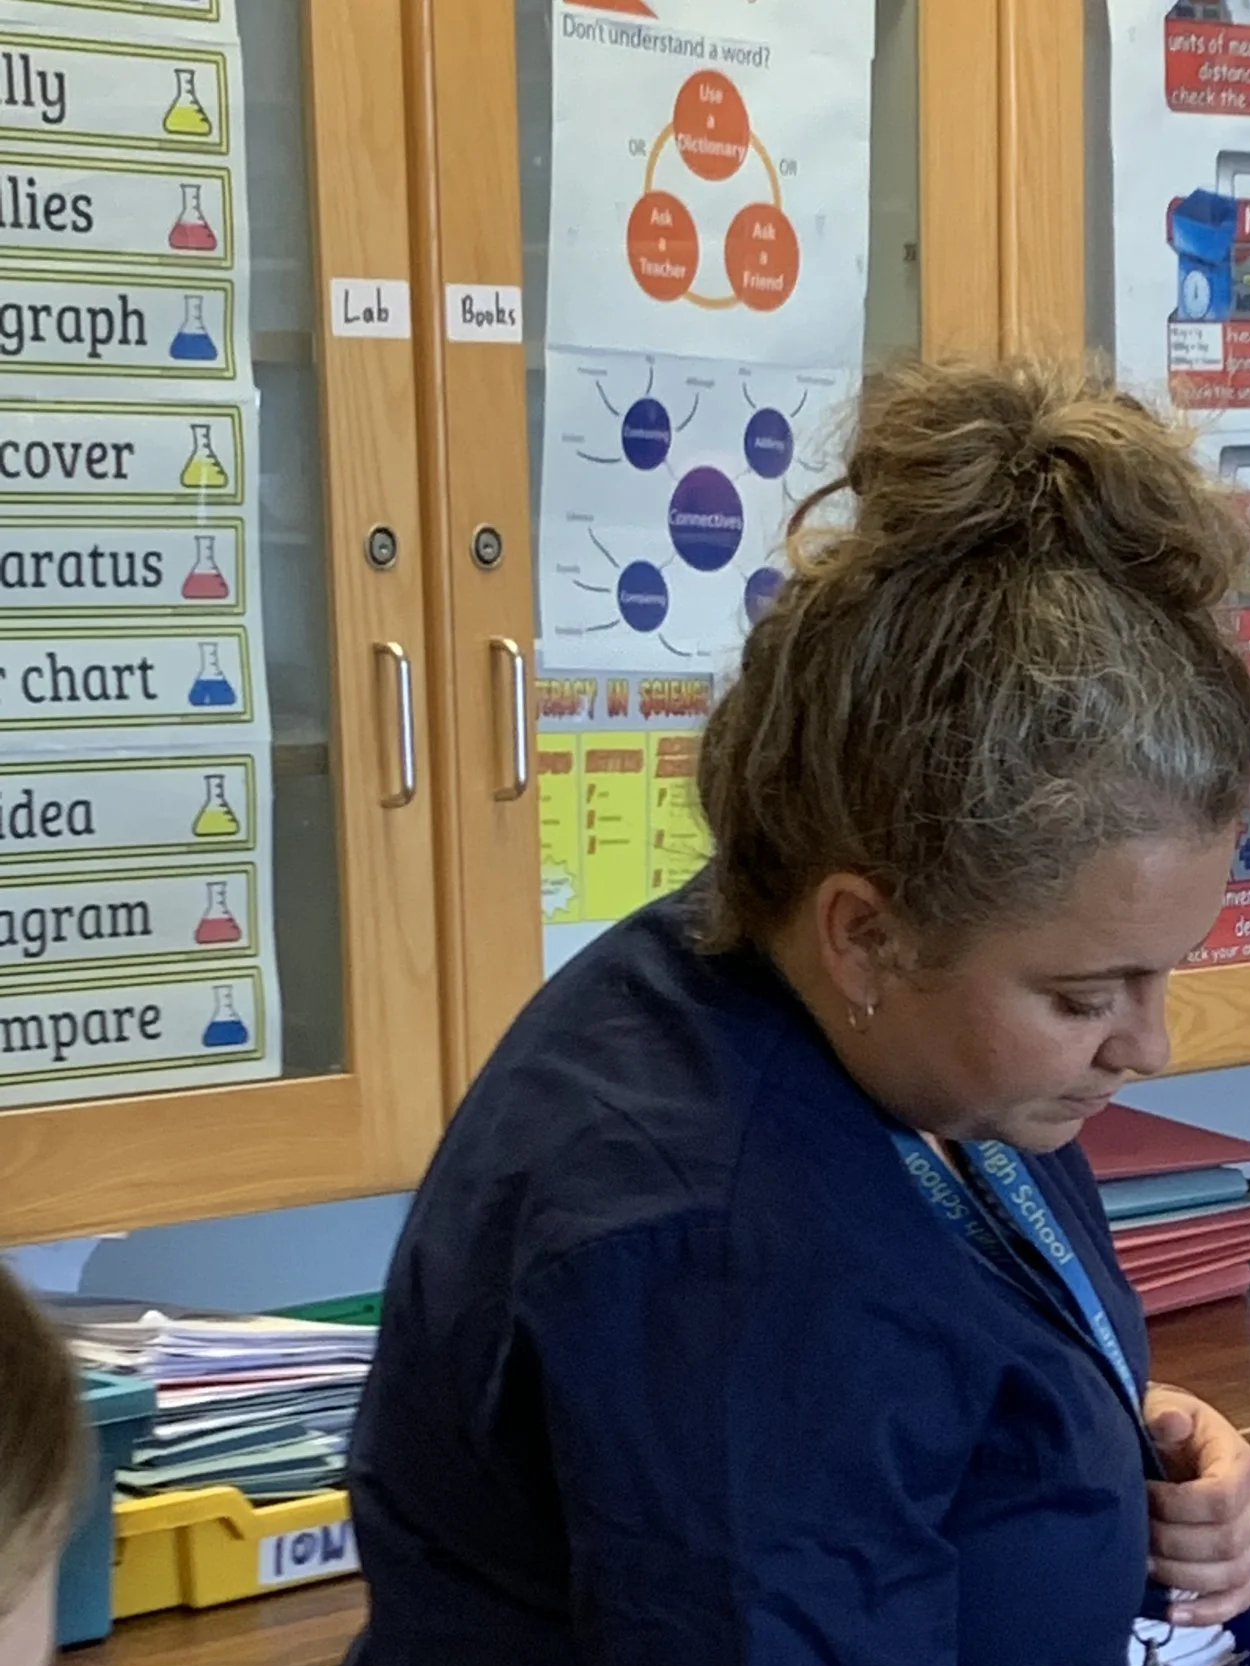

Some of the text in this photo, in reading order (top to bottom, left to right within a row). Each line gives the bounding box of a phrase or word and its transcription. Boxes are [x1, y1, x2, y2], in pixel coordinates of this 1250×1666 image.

[562, 13, 771, 68] Don't understand a word?
[1169, 36, 1205, 54] units
[1208, 29, 1224, 54] of
[700, 83, 723, 104] Use
[1172, 87, 1216, 105] check
[1220, 88, 1245, 107] the
[707, 114, 716, 130] a
[628, 138, 646, 157] OR
[677, 132, 746, 162] Dictionary
[651, 208, 673, 227] Ask
[752, 222, 776, 241] Ask
[640, 258, 686, 279] Teacher
[743, 271, 784, 291] Friend
[344, 287, 389, 323] Lab
[461, 291, 516, 327] Books
[0, 294, 147, 358] graph
[0, 440, 134, 480] cover
[669, 508, 743, 530] Connectives
[0, 545, 163, 588] aratus
[22, 652, 158, 703] chart
[0, 1004, 162, 1061] mpare
[1011, 1183, 1075, 1266] School
